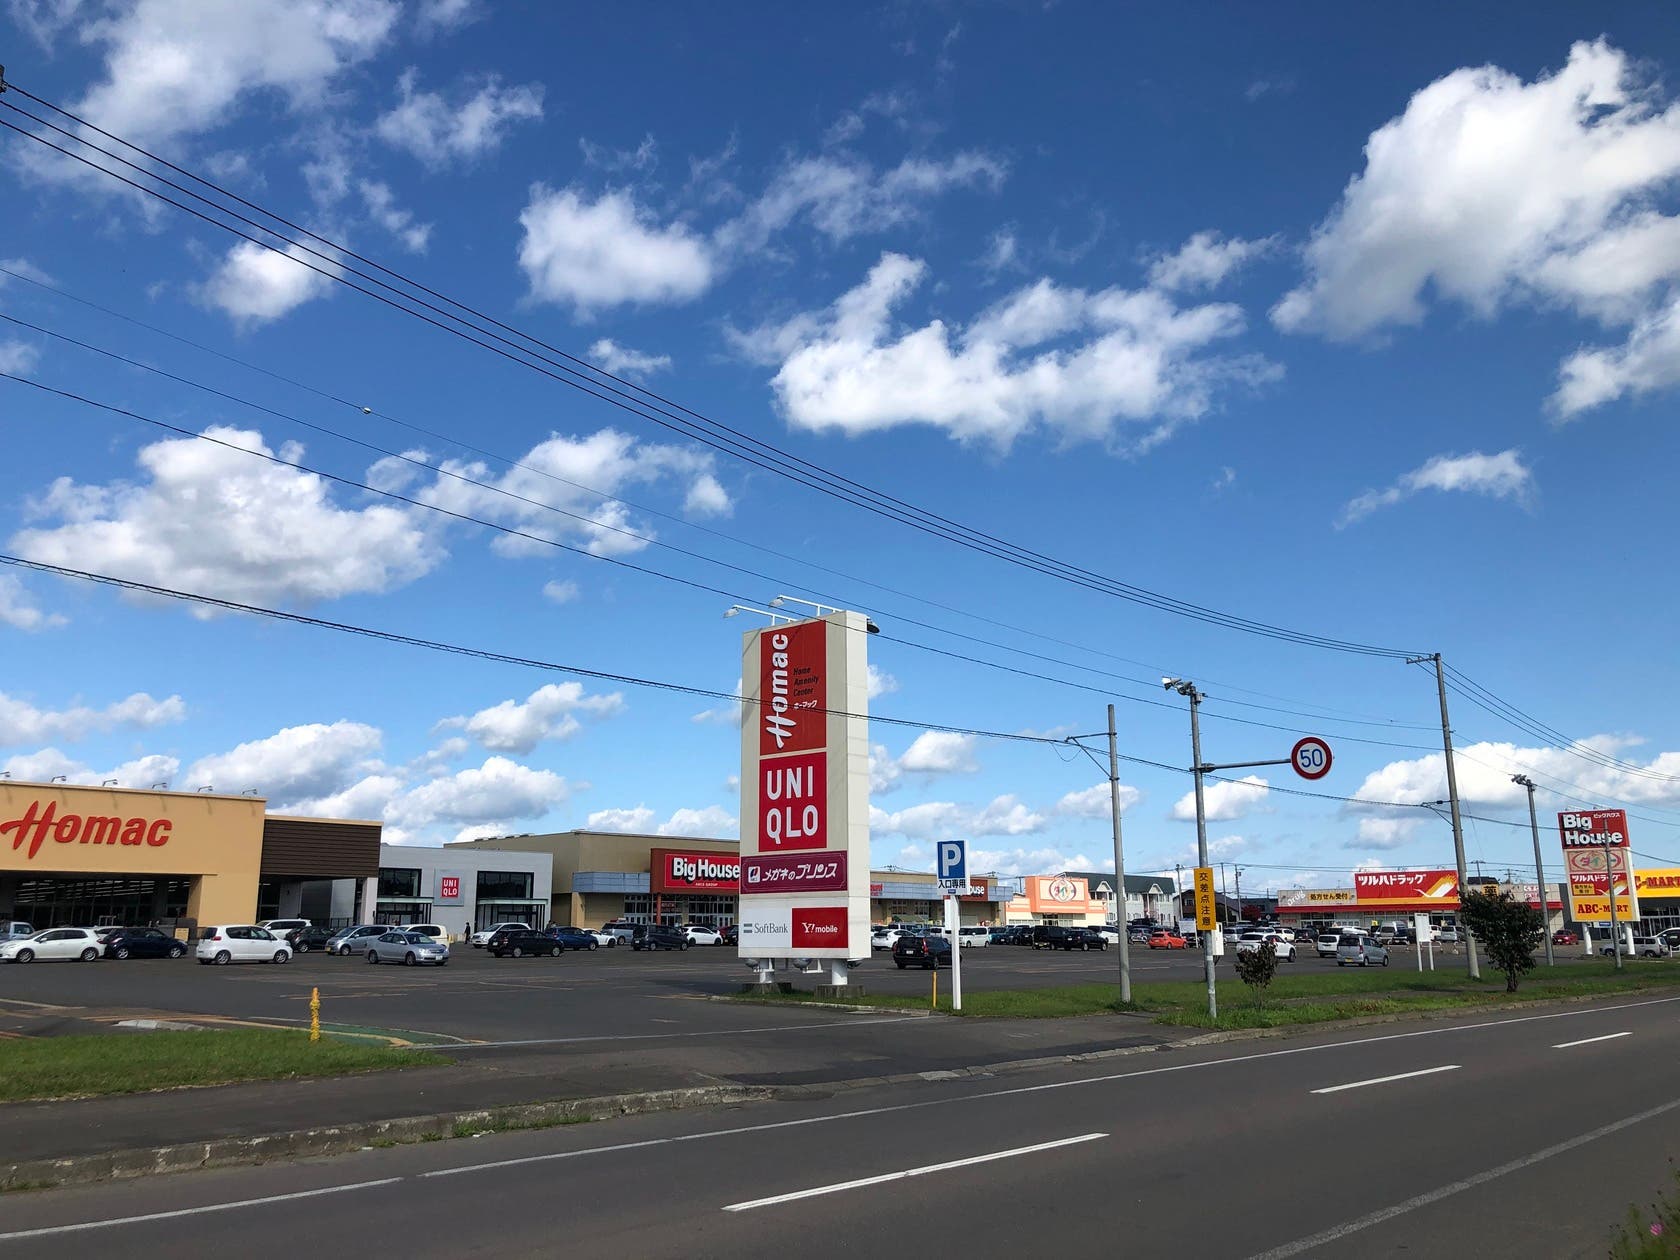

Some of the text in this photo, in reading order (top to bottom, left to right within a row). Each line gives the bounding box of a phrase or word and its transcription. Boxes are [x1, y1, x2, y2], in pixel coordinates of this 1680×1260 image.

[793, 667, 811, 676] Home
[794, 675, 819, 686] Amenity
[766, 633, 797, 749] Homac
[793, 687, 814, 697] Center
[1300, 748, 1323, 768] 50
[766, 765, 814, 801] UNI
[766, 804, 819, 845] QLO
[1563, 814, 1593, 830] Big
[0, 800, 173, 859] Homac
[942, 843, 962, 877] P
[673, 857, 740, 881] Big House
[761, 862, 838, 882] メガネのプリンス
[443, 878, 458, 887] UNI
[938, 879, 966, 889] 入口専用
[1358, 873, 1426, 886] ツルハドラッグ
[443, 888, 458, 898] QLO
[1199, 872, 1211, 926] 交差点注意
[1310, 892, 1348, 901] 処方せん受付
[1577, 903, 1629, 914] ABC-MRT
[754, 923, 789, 934] SoftBank
